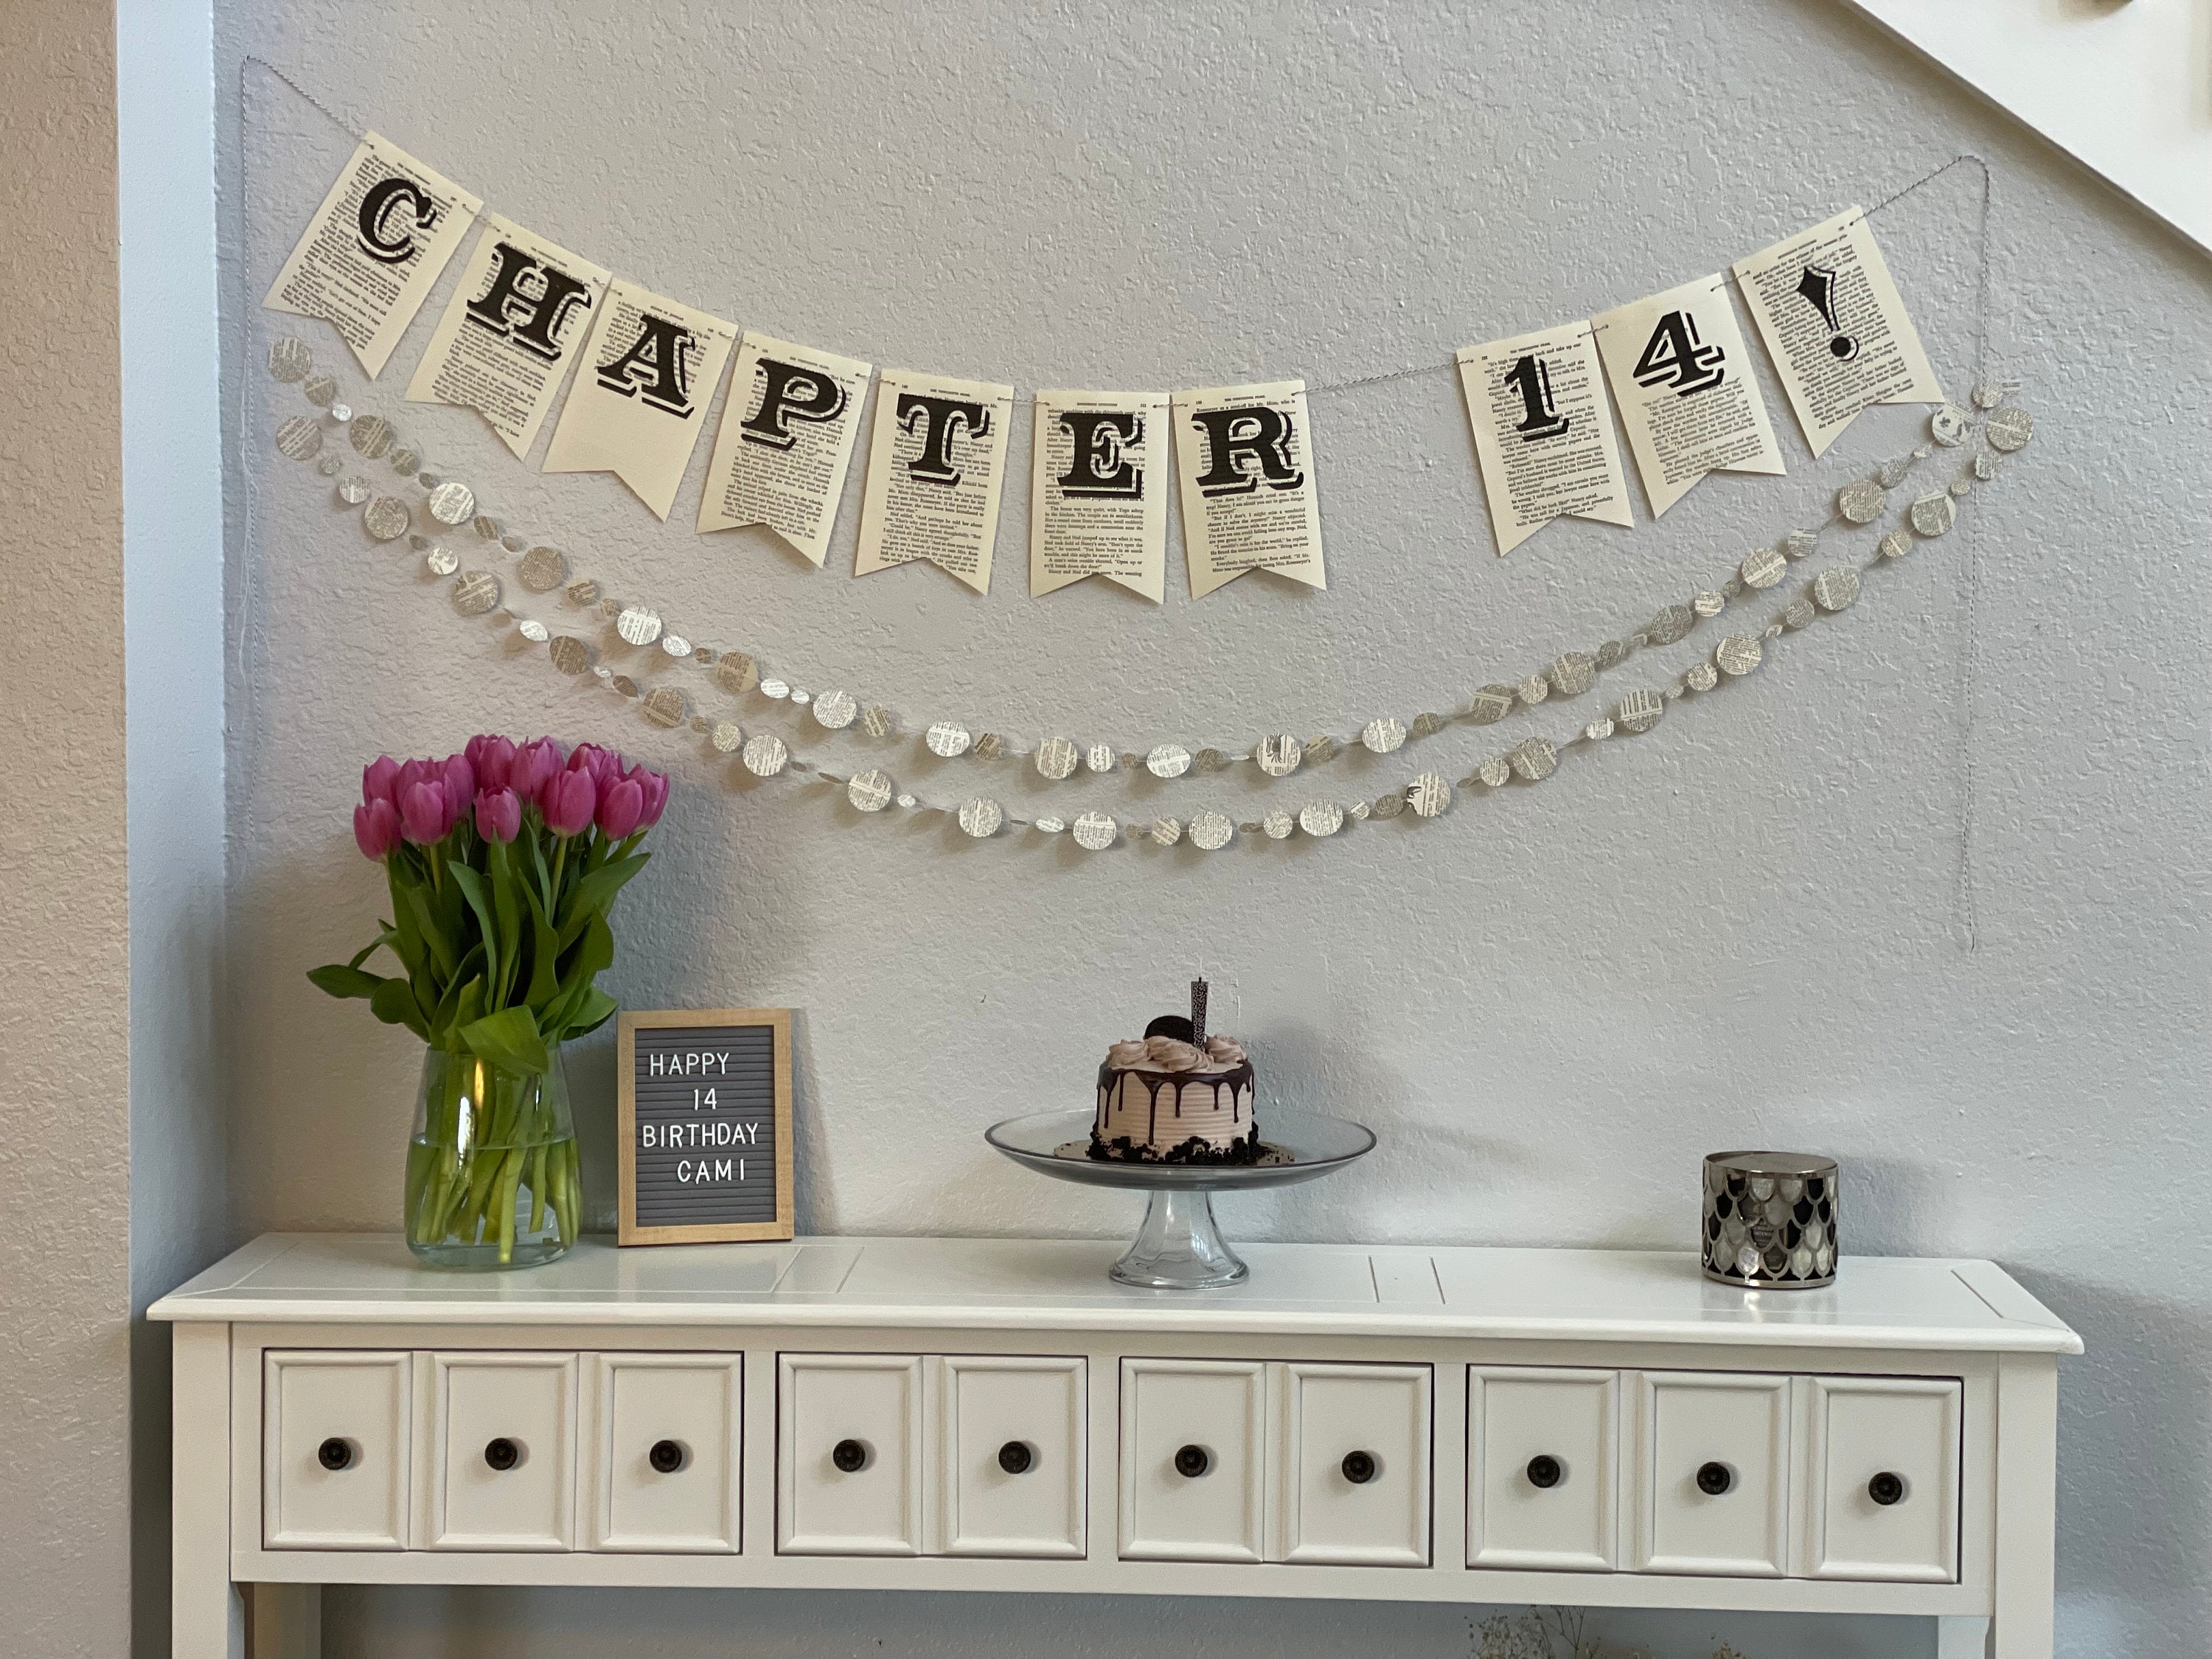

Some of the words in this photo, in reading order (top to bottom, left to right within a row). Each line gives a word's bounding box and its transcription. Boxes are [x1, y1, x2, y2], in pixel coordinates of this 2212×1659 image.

[358, 178, 1304, 498] CHAPTER
[649, 1052, 729, 1077] HAPPY
[692, 1088, 717, 1110] 14
[643, 1122, 759, 1149] BIRTHDAY
[677, 1158, 745, 1184] CAMI
